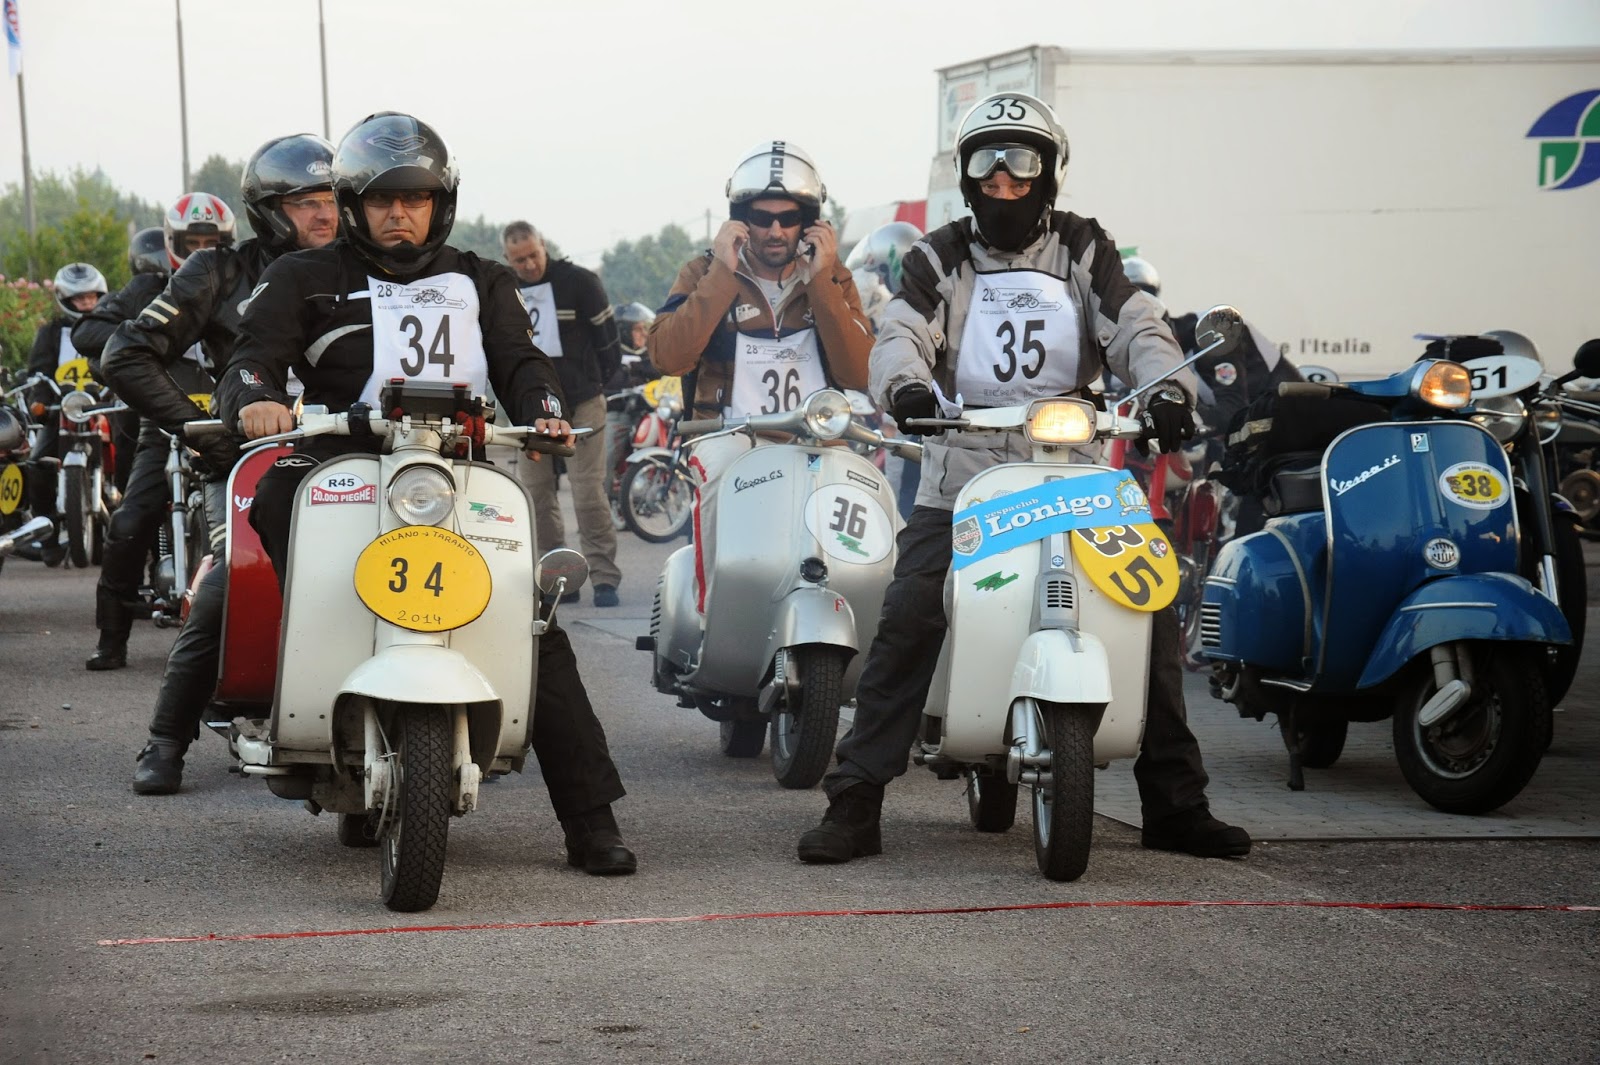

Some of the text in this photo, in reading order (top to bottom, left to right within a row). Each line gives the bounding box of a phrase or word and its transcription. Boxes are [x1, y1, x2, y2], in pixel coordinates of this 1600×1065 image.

[986, 98, 1027, 121] 35
[400, 314, 455, 378] 34
[993, 319, 1047, 383] 35
[1300, 338, 1371, 354] l'Italia
[761, 368, 802, 415] 36
[328, 478, 355, 488] R45
[734, 476, 768, 493] Vespa
[1330, 466, 1381, 496] Vespa
[1462, 474, 1492, 498] 38
[312, 488, 339, 502] 20.000
[340, 487, 371, 502] PIEGHE
[829, 496, 867, 539] 36
[984, 498, 1039, 520] vespa club
[985, 495, 1113, 537] Lonigo
[380, 530, 419, 547] MILANO
[433, 530, 475, 557] TARANTO
[1075, 525, 1164, 606] 35
[397, 609, 442, 625] 2014
